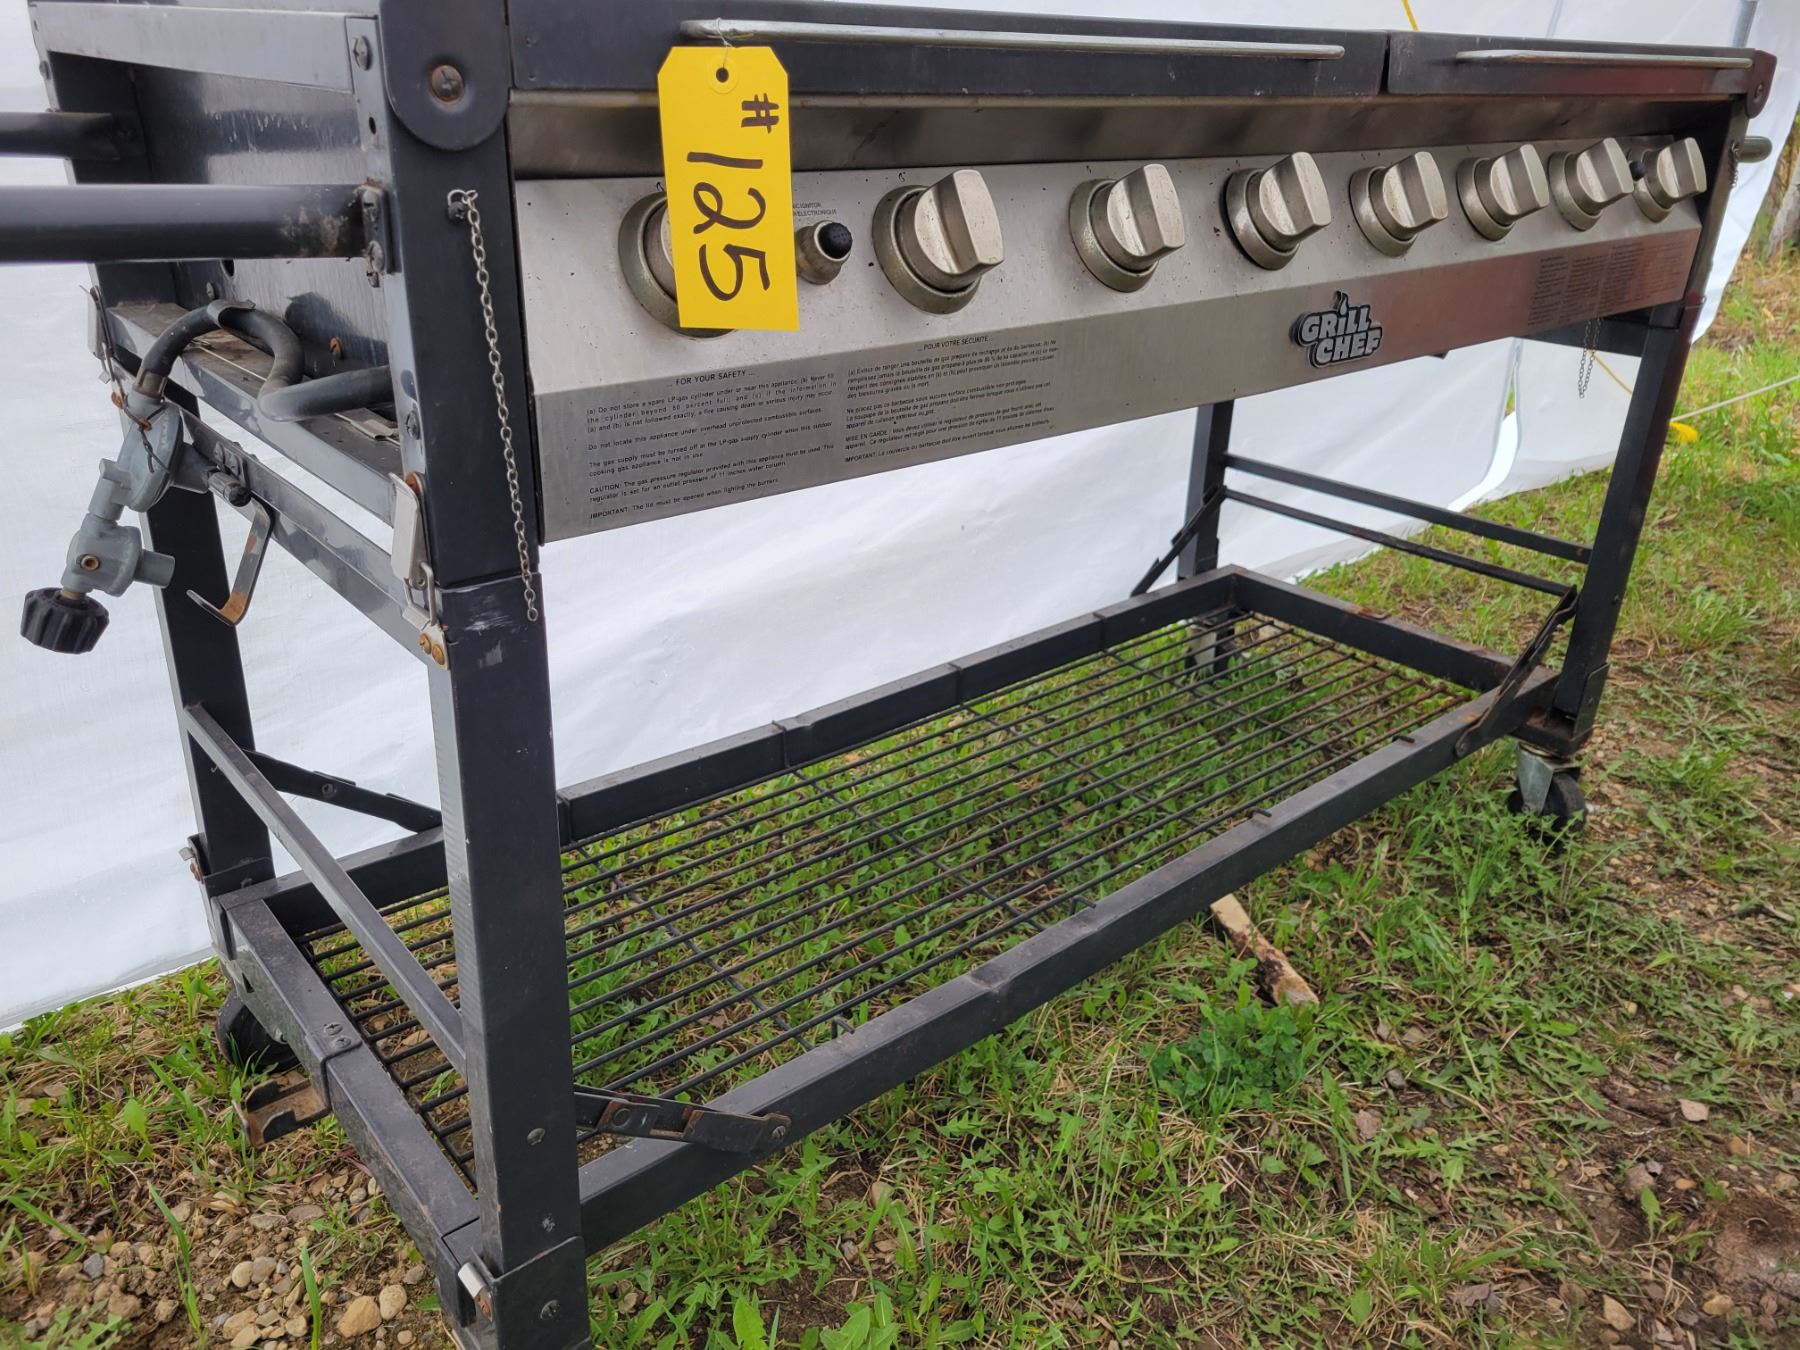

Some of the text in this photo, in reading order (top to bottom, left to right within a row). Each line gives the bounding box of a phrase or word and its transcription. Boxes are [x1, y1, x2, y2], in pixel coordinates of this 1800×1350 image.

[923, 342, 940, 351] POUR
[941, 339, 960, 348] VOTRE
[1314, 328, 1382, 365] CHEF
[675, 370, 746, 386] FOR YOUR SAFETY
[604, 411, 635, 423] cylinder
[641, 406, 667, 417] beyond
[685, 399, 712, 410] percent
[790, 382, 827, 393] information
[623, 402, 639, 410] store
[648, 399, 665, 407] spare
[668, 394, 688, 404] LP-gas
[690, 390, 714, 401] cylinder
[645, 414, 672, 423] followed
[716, 404, 738, 414] causing
[613, 438, 632, 446] locate
[649, 430, 678, 442] appliance
[680, 427, 698, 435] under
[700, 422, 727, 432] overhead
[868, 429, 888, 438] GARDE
[617, 454, 638, 464] supply
[640, 451, 656, 459] must
[667, 445, 688, 454] turned
[719, 437, 739, 447] LP-gas
[761, 429, 782, 439] cylinder
[589, 467, 615, 478] cooking
[631, 459, 661, 471] appliance
[636, 478, 648, 486] gas
[650, 473, 676, 484] pressure
[678, 467, 704, 479] regulator
[705, 462, 731, 474] provided
[758, 452, 784, 464] appliance
[590, 491, 618, 504] regulator
[662, 480, 680, 488] outlet
[682, 476, 708, 486] pressure
[728, 467, 746, 476] inches
[683, 492, 704, 502] opened
[723, 484, 745, 494] lighting
